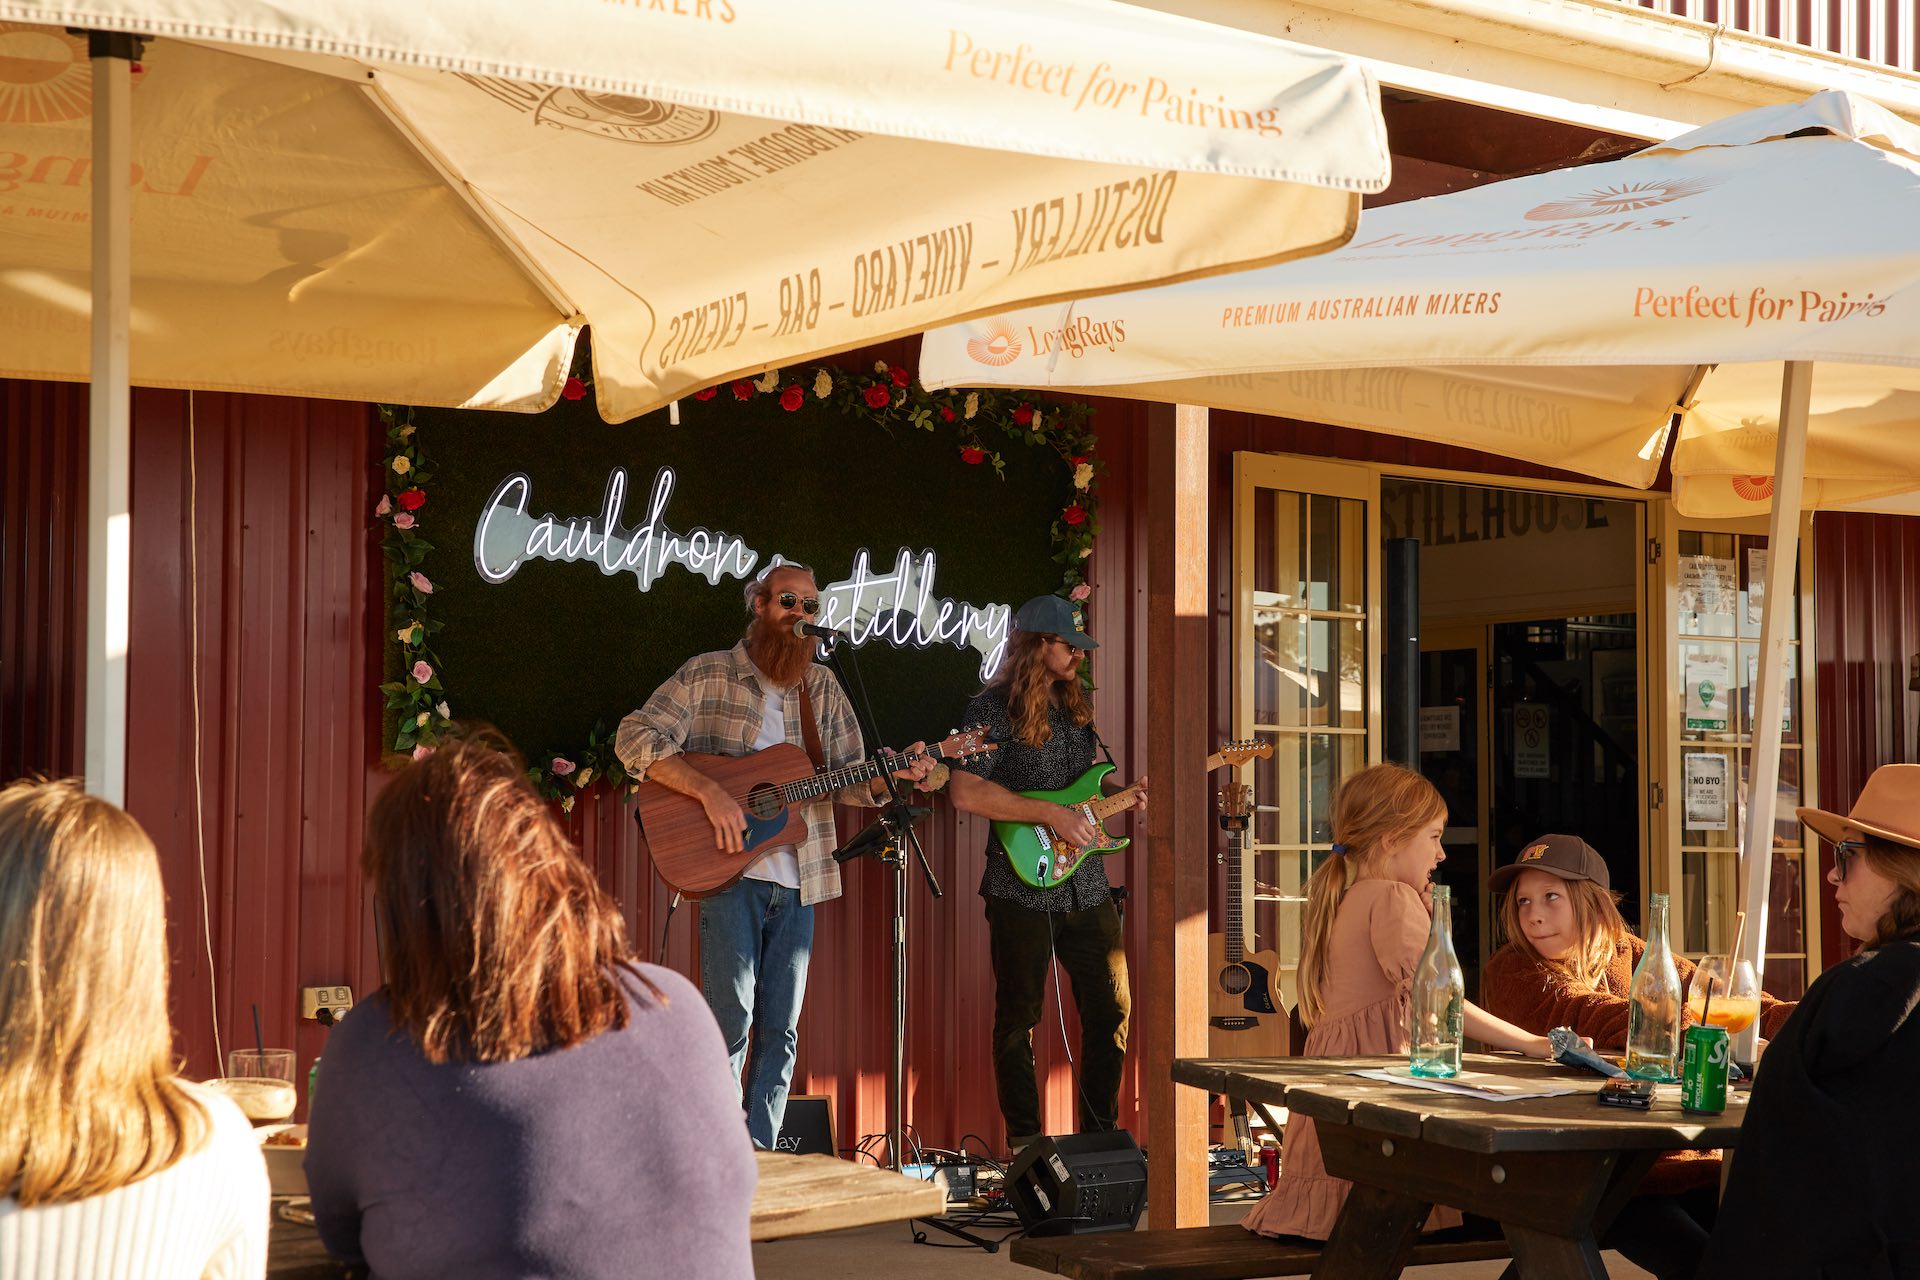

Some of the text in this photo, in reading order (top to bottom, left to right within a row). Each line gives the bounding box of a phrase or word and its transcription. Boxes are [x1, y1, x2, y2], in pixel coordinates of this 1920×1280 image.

[943, 29, 1283, 138] Perfect for Pairing
[1222, 291, 1502, 329] PREMIUM AUSTRALIAN MIXERS
[1633, 285, 1741, 318] Perfect
[1744, 286, 1794, 328] for
[479, 469, 756, 589] Cauldron
[1693, 776, 1720, 785] NO BYO
